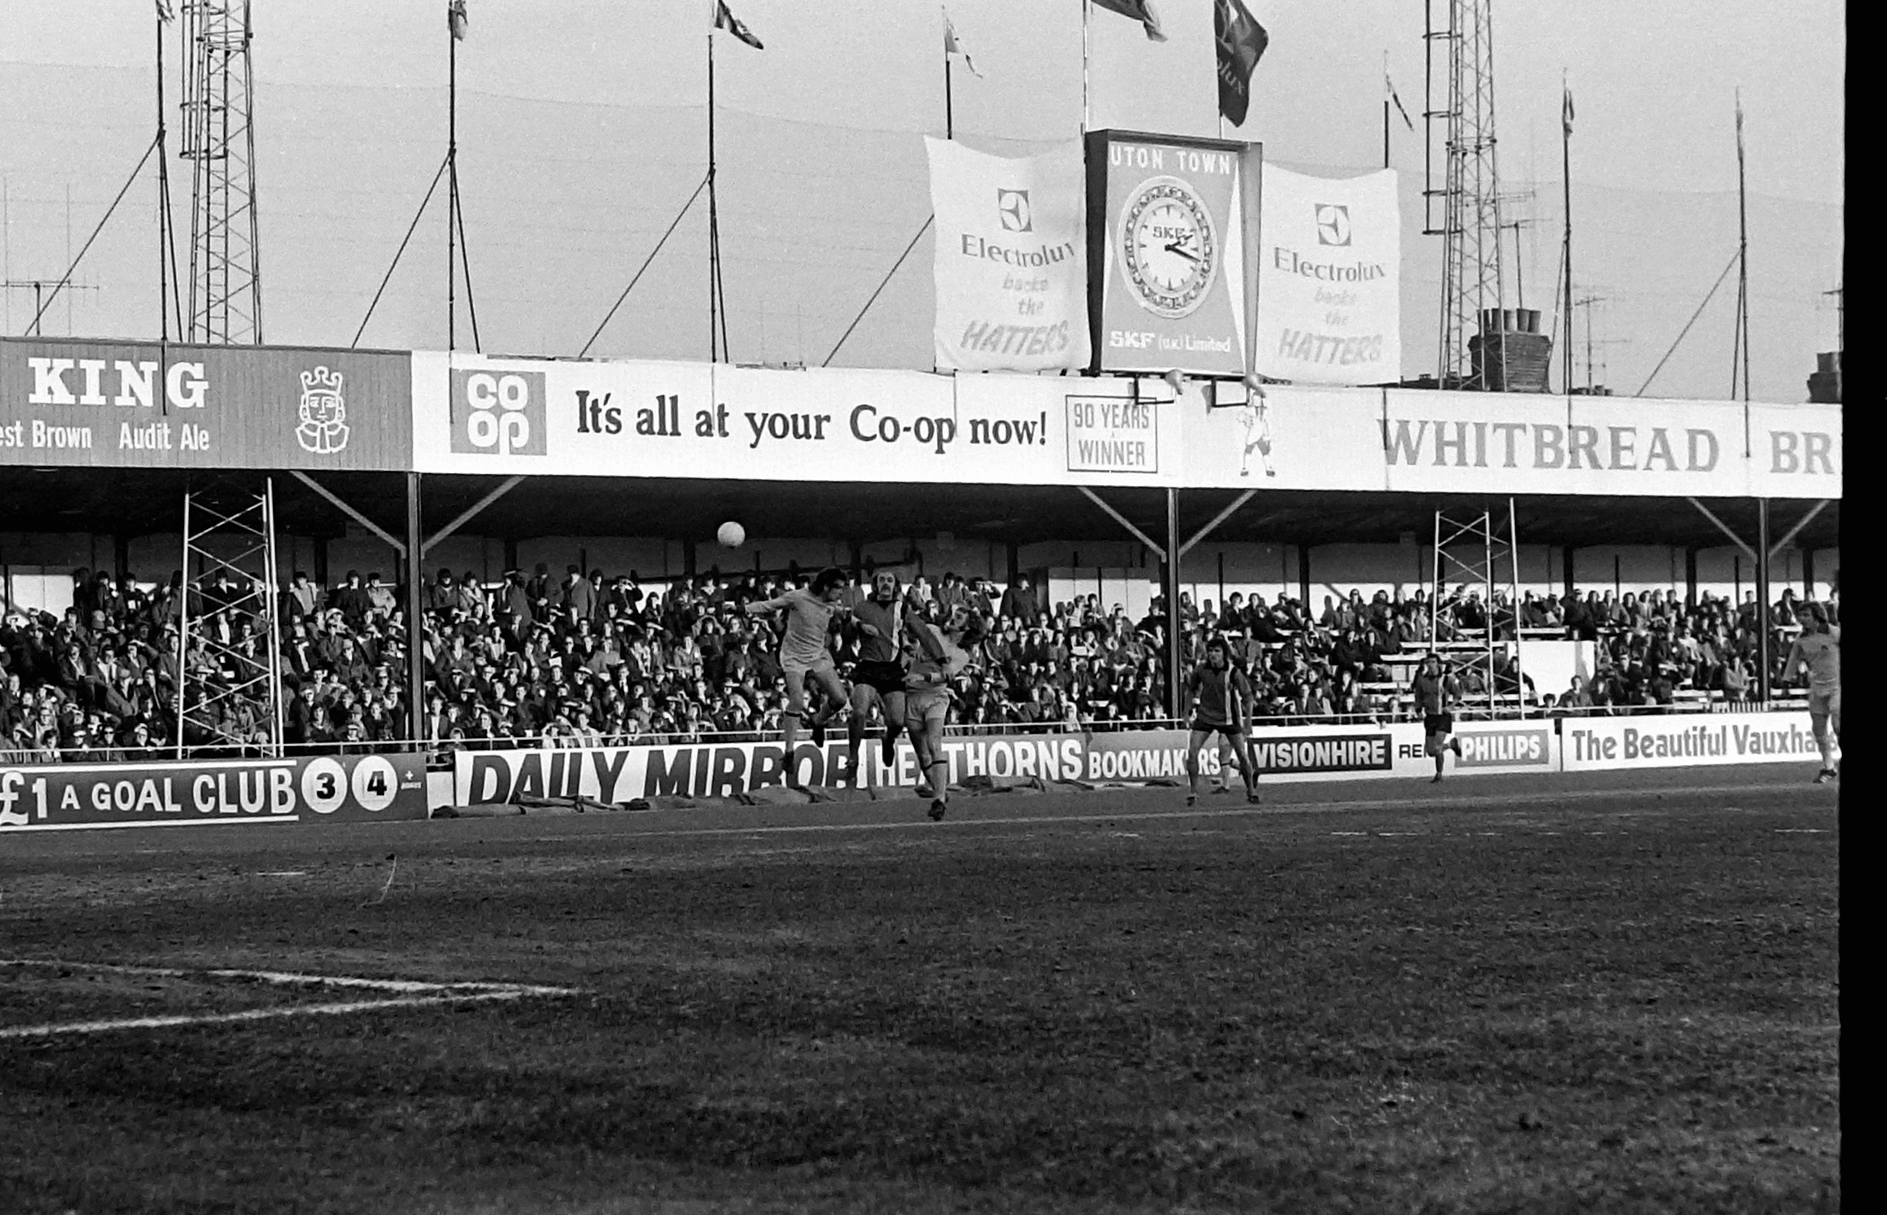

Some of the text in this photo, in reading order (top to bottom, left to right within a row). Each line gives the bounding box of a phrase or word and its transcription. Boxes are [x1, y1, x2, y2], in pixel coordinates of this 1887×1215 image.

[1110, 145, 1230, 175] UTON TOWN
[1153, 226, 1185, 239] SKF
[1274, 246, 1385, 281] Electrolux
[1018, 297, 1044, 316] the
[960, 320, 1069, 356] HATTERS
[1109, 330, 1156, 349] SKF
[1185, 332, 1231, 353] Limited
[1278, 328, 1383, 365] HATTERS
[28, 357, 210, 409] KING
[575, 389, 1047, 454] It's all at your Co-op now!
[1073, 402, 1150, 429] 90 YEARS
[32, 419, 92, 449] Brown
[119, 421, 172, 450] Audit
[180, 423, 210, 451] Ale
[1078, 439, 1146, 466] WINNER
[1376, 418, 1835, 475] WHITBREAD BR
[1252, 739, 1386, 768] VISIONHIRE
[1460, 734, 1541, 763] PHILIPS
[1572, 722, 1838, 761] The Beautiful Vauxha
[468, 750, 631, 806] DAILY
[874, 738, 1222, 788] HETHORNS BOOKMAKRS
[0, 768, 297, 826] £1 A GOAL CLUB
[314, 770, 389, 800] 3 4
